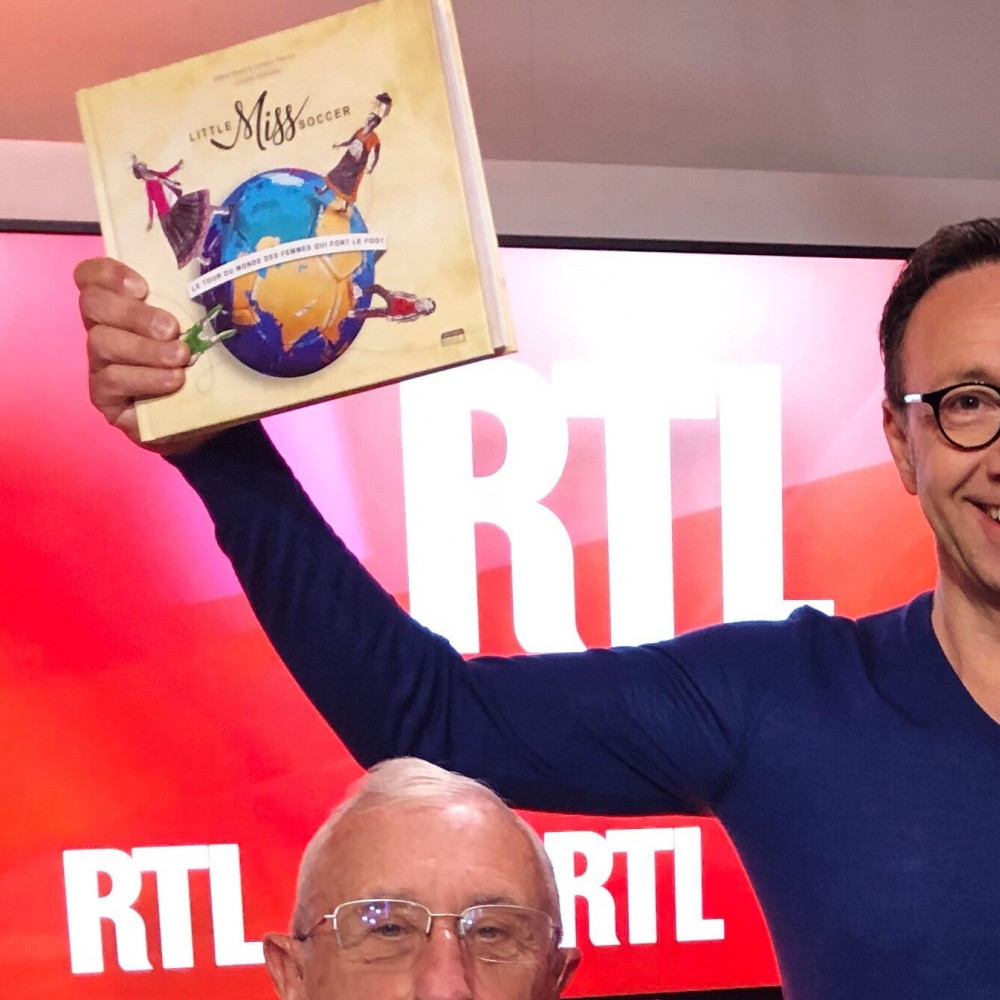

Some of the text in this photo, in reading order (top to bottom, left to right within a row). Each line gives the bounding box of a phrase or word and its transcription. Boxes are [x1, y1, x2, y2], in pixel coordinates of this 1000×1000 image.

[188, 90, 352, 150] LITTLE Miss SOCCER
[236, 257, 261, 272] MONDE
[264, 252, 279, 263] DES
[281, 244, 312, 257] FEMMES
[314, 242, 328, 250] QUI
[329, 239, 350, 247] FONT
[399, 359, 835, 653] RTL
[62, 843, 266, 974] RTL
[543, 826, 725, 949] RTL
